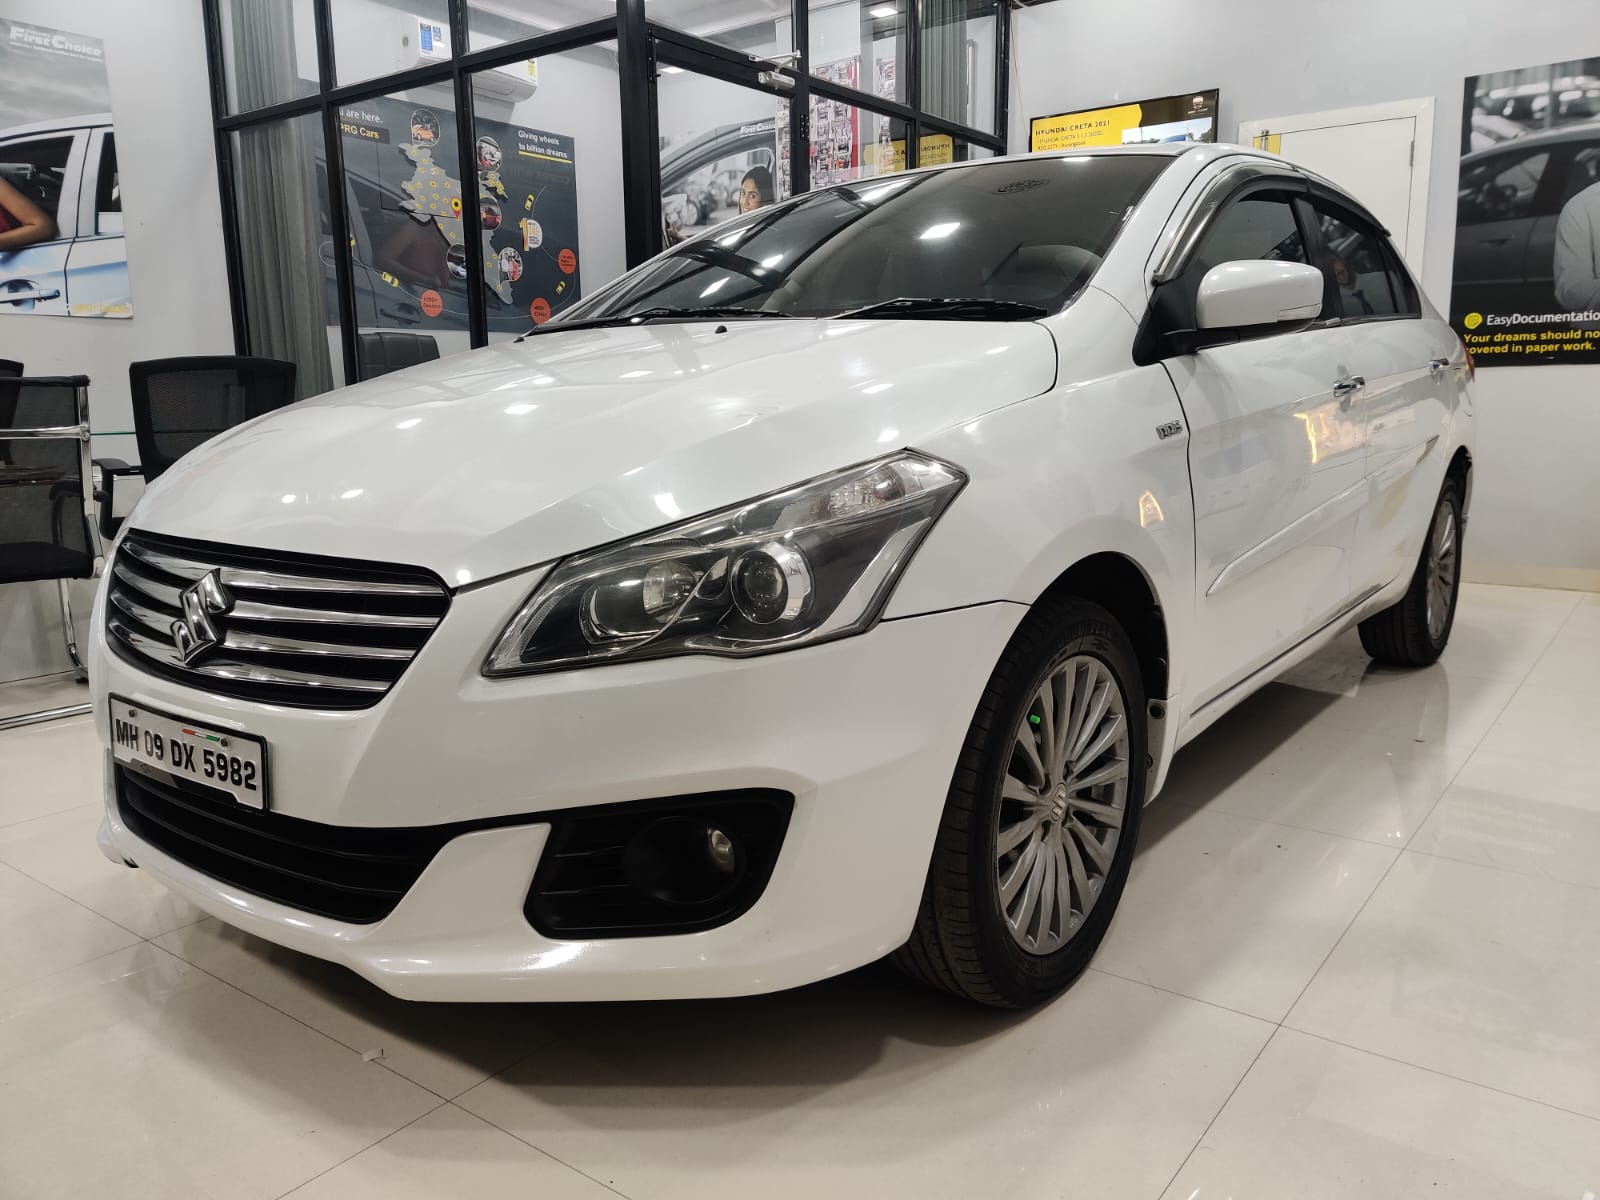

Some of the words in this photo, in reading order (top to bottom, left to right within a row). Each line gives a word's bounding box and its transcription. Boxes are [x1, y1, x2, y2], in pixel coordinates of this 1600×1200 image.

[346, 109, 360, 119] are
[361, 110, 384, 124] here.
[359, 127, 380, 139] Cars
[1035, 127, 1068, 136] HYUNDAI
[1069, 122, 1093, 131] CRETA
[1095, 119, 1110, 128] 2021
[518, 130, 538, 143] Giving
[538, 135, 560, 145] wheels
[518, 142, 526, 150] to
[526, 144, 545, 154] billion
[545, 148, 568, 159] dreams
[1464, 333, 1491, 344] Your
[1493, 331, 1537, 342] dreams
[1540, 329, 1582, 340] should
[1467, 344, 1508, 354] overed
[1512, 343, 1522, 352] in
[1525, 345, 1560, 354] paper
[1563, 341, 1596, 351] work.
[115, 718, 139, 751] MH
[144, 730, 164, 761] 09
[170, 739, 196, 773] DX
[203, 748, 257, 791] 5982
